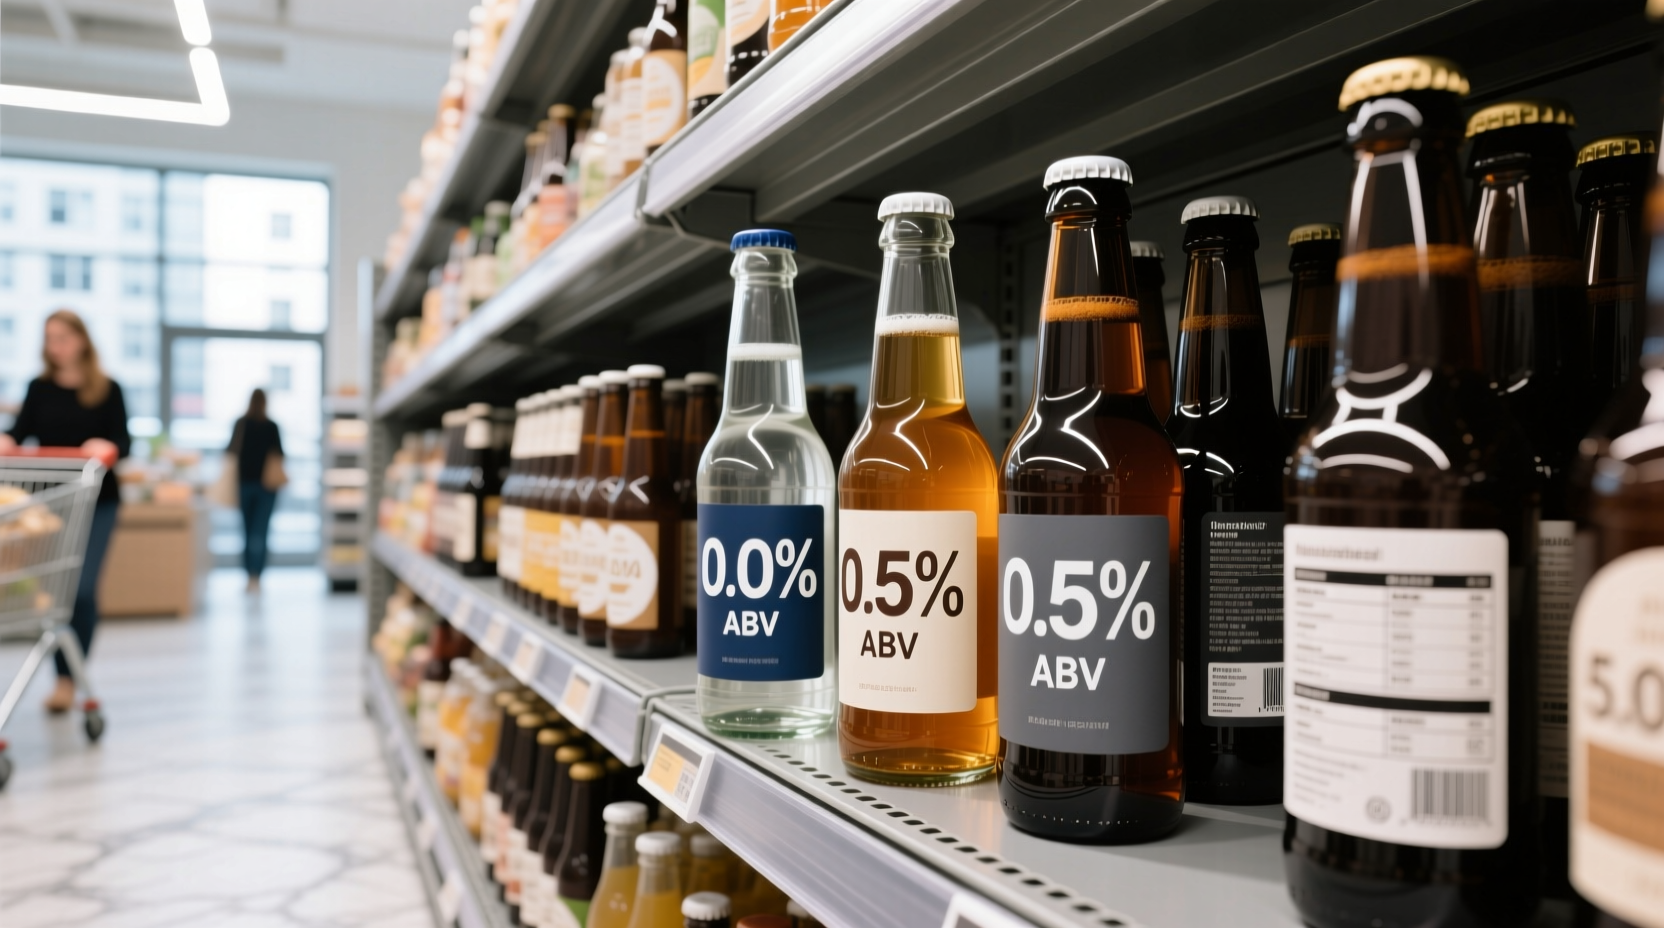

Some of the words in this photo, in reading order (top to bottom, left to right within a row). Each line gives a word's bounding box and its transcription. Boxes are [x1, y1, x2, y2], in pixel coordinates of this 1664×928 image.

[701, 537, 817, 599] 0.0%
[841, 548, 964, 618] 0.5%
[722, 610, 780, 637] ABV
[1003, 557, 1155, 641] 0.5%
[860, 630, 919, 659] ABV
[1030, 654, 1106, 691] ABV
